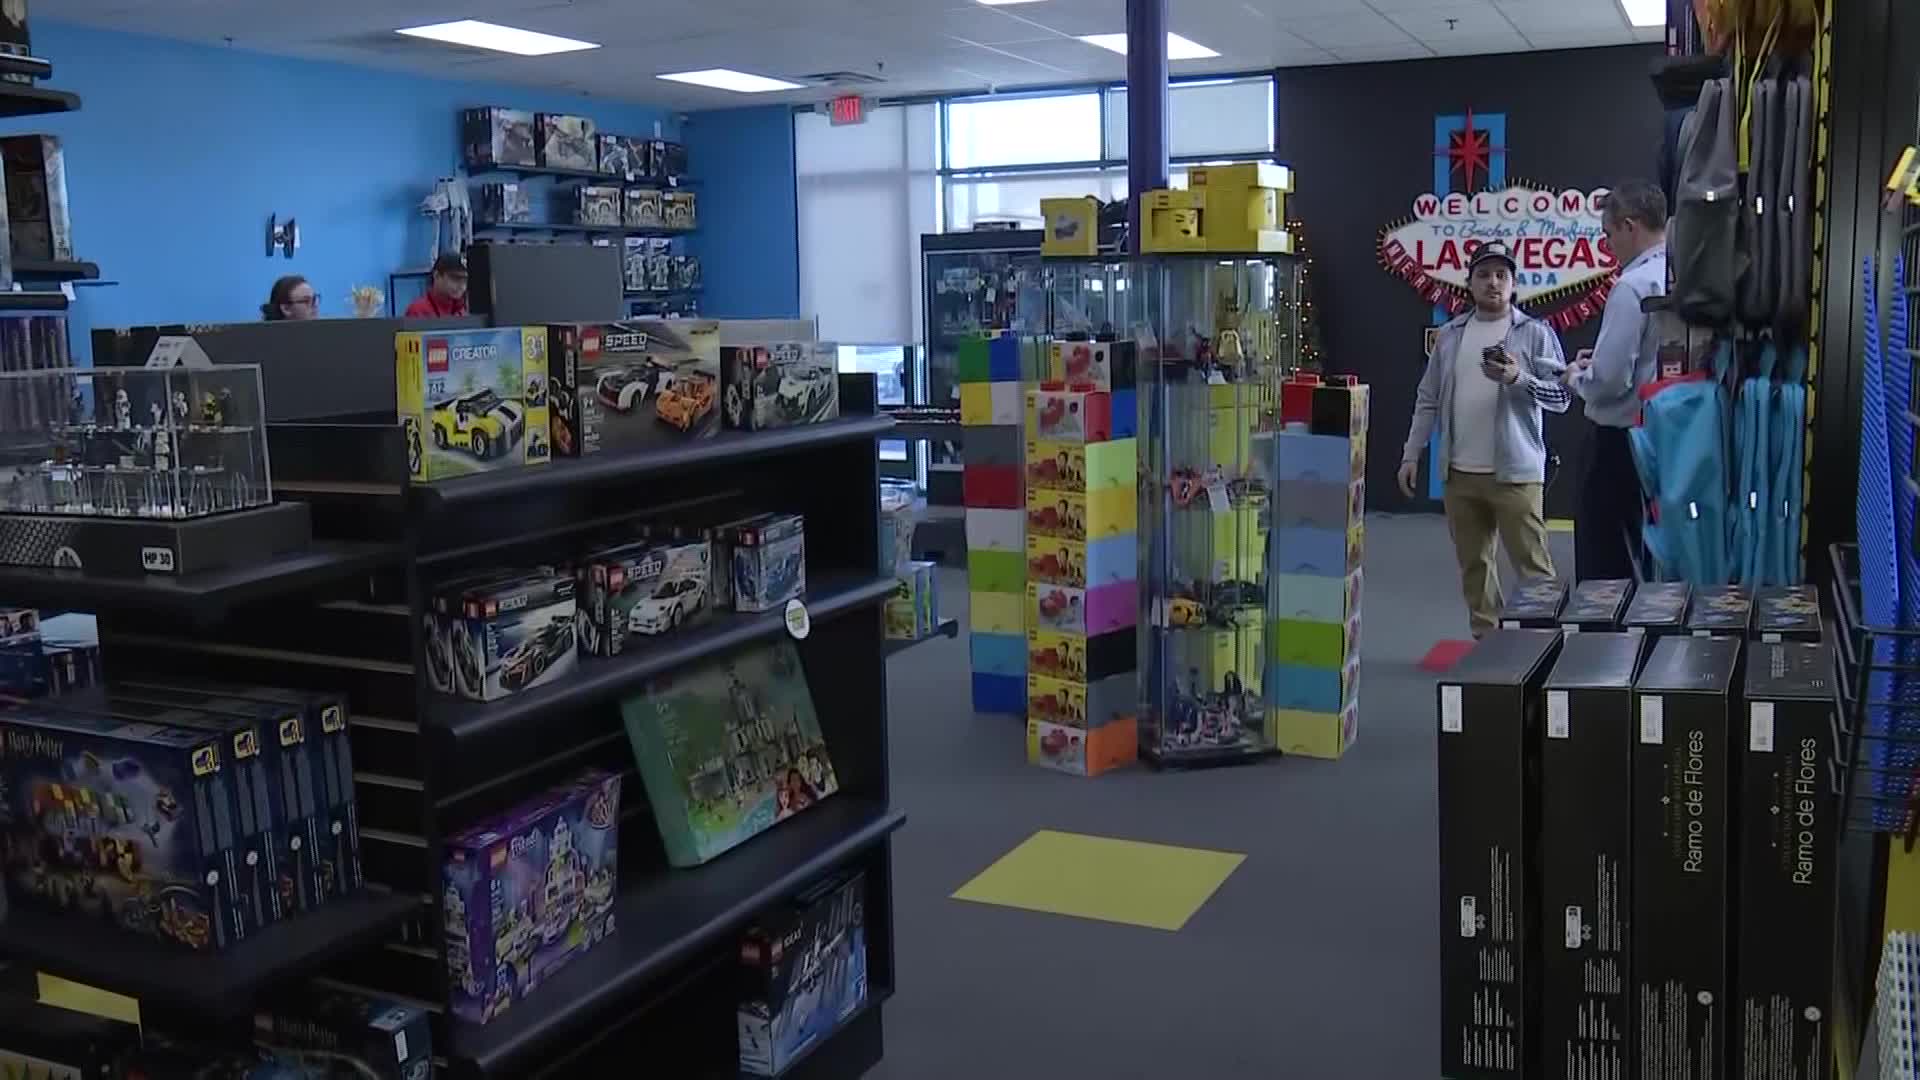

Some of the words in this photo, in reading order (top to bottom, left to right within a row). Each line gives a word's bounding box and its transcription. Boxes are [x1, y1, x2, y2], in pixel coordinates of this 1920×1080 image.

[1432, 225, 1455, 237] TO
[1385, 242, 1461, 313] MERRY
[452, 344, 497, 362] CREATOR
[604, 332, 648, 348] SPEED
[1683, 728, 1704, 786] Flores
[1795, 737, 1817, 795] Flores
[1684, 790, 1704, 816] de
[1795, 799, 1815, 827] de
[1682, 821, 1704, 873] Ramo
[1792, 830, 1815, 885] Ramo
